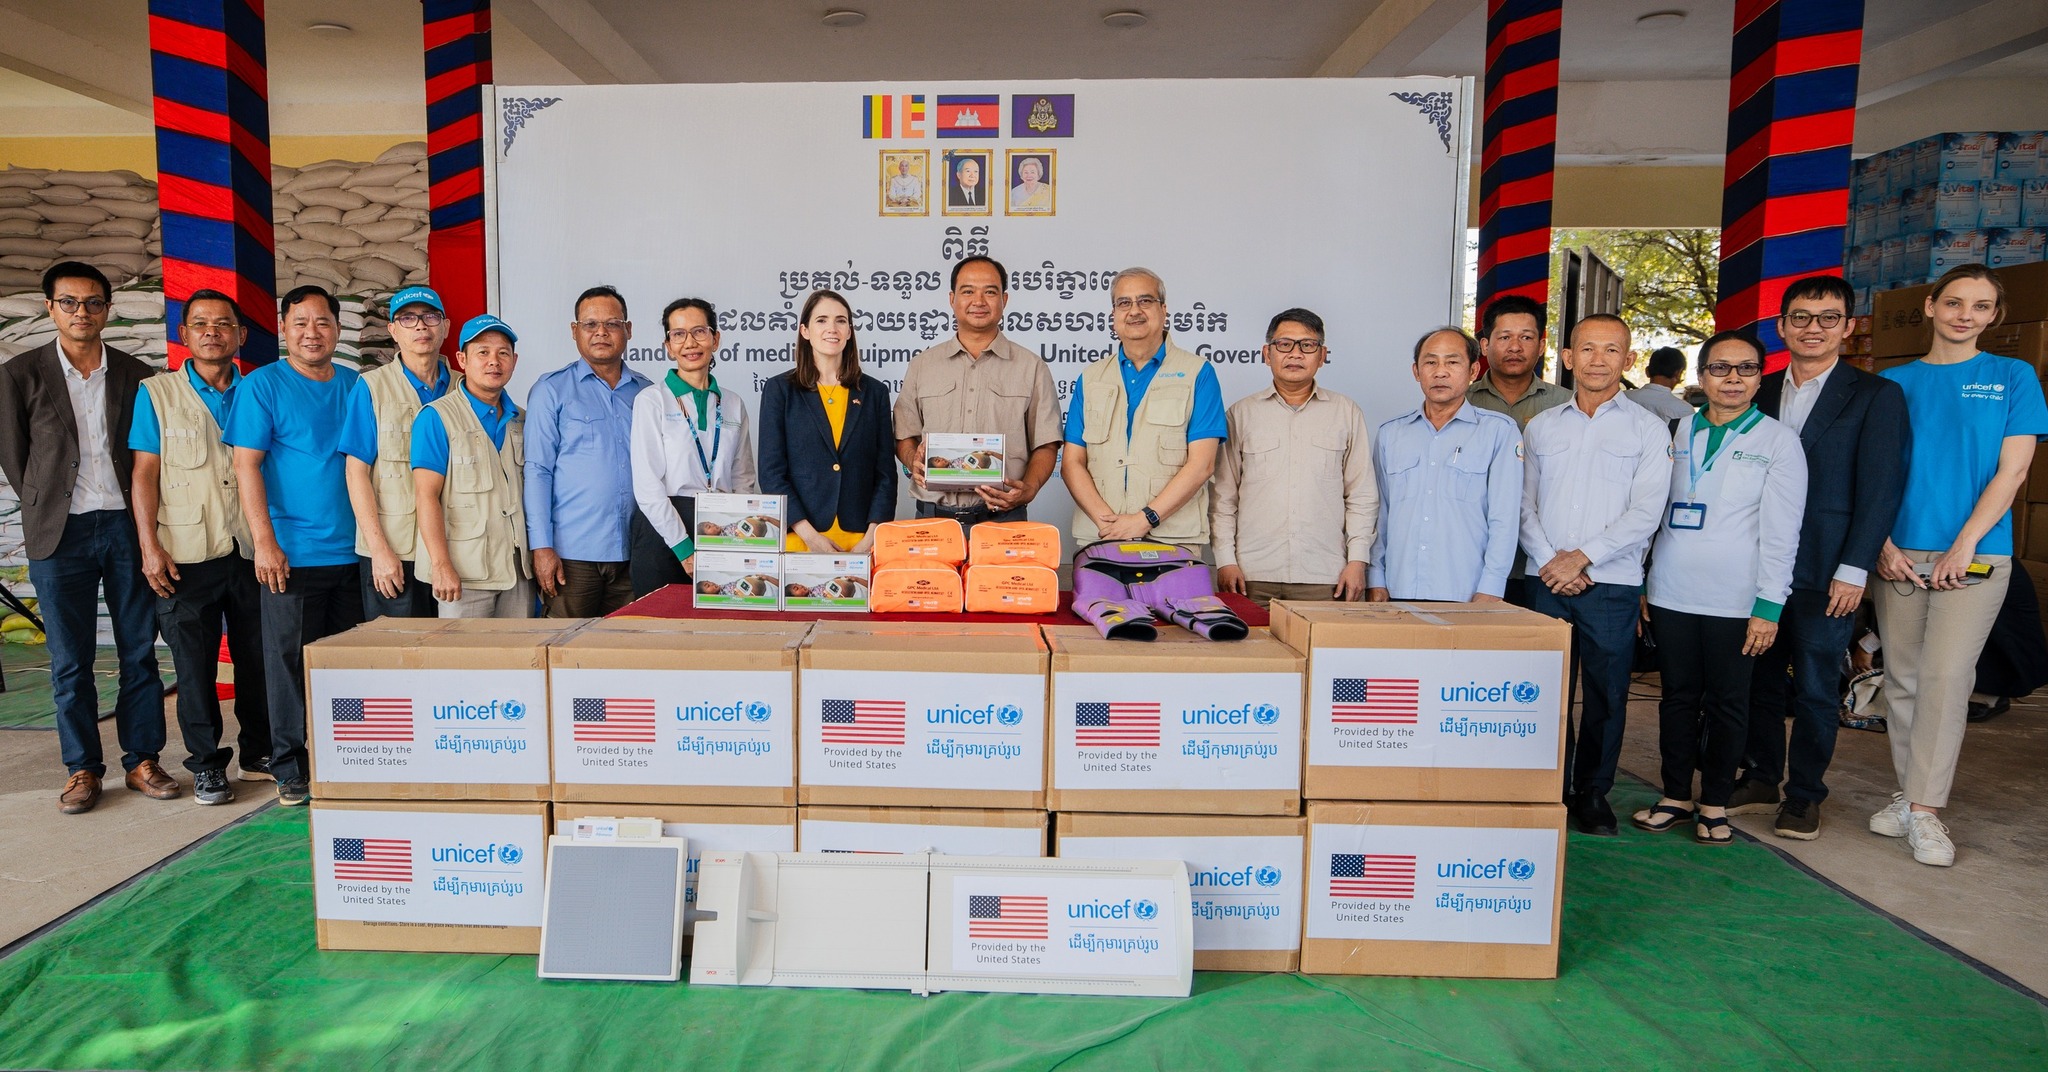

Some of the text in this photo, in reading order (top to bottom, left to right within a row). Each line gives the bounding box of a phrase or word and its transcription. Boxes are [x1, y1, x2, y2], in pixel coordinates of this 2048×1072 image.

[1950, 183, 1975, 193] Vital
[395, 291, 422, 304] unicef
[719, 343, 740, 362] of
[746, 343, 796, 362] medi
[1962, 382, 1993, 392] unicef
[1441, 681, 1511, 702] unicef
[433, 700, 498, 720] unicef
[677, 701, 743, 721] unicef
[927, 704, 994, 724] unicef
[1183, 704, 1251, 725] unicef
[1334, 727, 1414, 738] Provided by the
[1339, 740, 1407, 748] United States
[337, 745, 378, 753] Provided
[382, 746, 393, 755] by
[577, 746, 653, 756] Provided by the
[824, 748, 904, 759] Provided by the
[343, 757, 374, 765] United
[1078, 751, 1122, 759] Provided
[1126, 751, 1137, 761] by
[583, 758, 648, 767] United States
[830, 760, 896, 769] United States
[432, 843, 495, 863] unicef
[1438, 859, 1506, 879] unicef
[338, 884, 411, 895] Provided by the
[343, 896, 406, 905] United States
[1068, 899, 1131, 919] unicef
[1332, 901, 1410, 912] Provided by the
[1337, 914, 1404, 923] United States
[972, 943, 1045, 954] Provided by the
[977, 955, 1040, 964] United States
